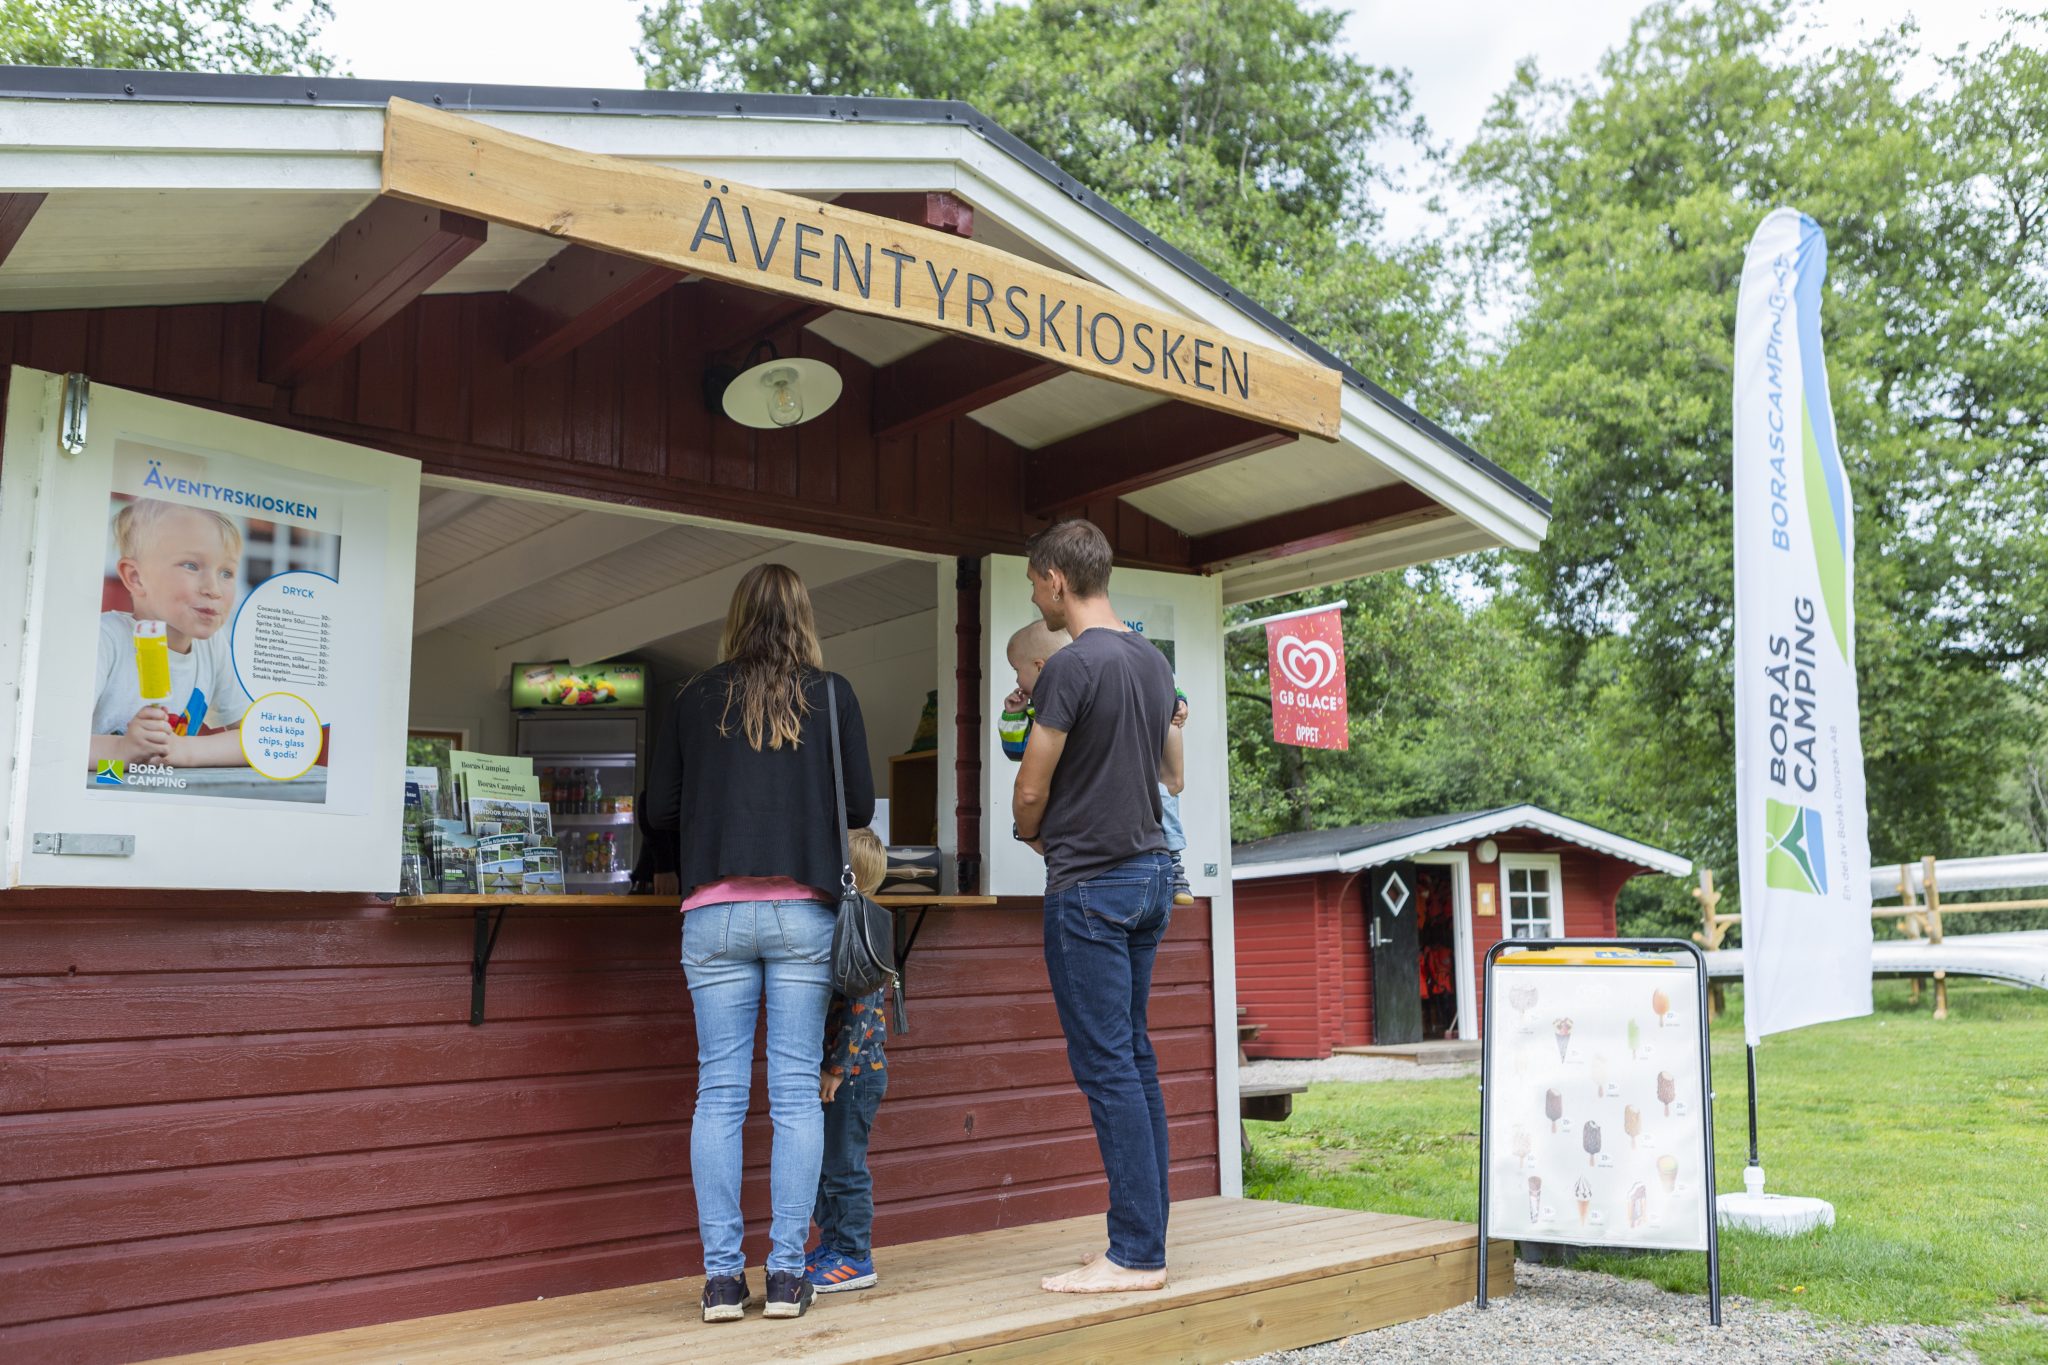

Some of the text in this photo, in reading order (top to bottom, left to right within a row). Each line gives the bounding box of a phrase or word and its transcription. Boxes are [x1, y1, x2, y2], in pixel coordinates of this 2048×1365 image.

[690, 179, 1249, 400] ÄVENTYRSKIOSKEN
[143, 460, 318, 520] ÄVENTYRSKIOSKEN
[282, 585, 315, 599] DRYCK
[257, 604, 281, 614] Cocacola
[256, 612, 280, 621] Cocacola
[256, 620, 272, 628] Sprite
[255, 627, 270, 635] Fanta
[269, 637, 288, 645] persika
[268, 644, 285, 652] citron
[254, 650, 291, 660] Elefantvatten,
[253, 658, 291, 668] Elefantvatten,
[253, 665, 272, 673] Smakis
[252, 673, 271, 681] Smakis
[1279, 689, 1337, 711] GB GLACE
[1794, 596, 1818, 793] CAMPING
[1765, 633, 1791, 787] BORÅS
[261, 711, 305, 724] Här kan du
[259, 725, 305, 736] också köpa
[1296, 722, 1319, 743] ÖPPET
[258, 736, 305, 748] chips, glass
[264, 749, 298, 760] & godis!
[128, 763, 174, 776] BORÅS
[481, 764, 511, 774] Camping
[127, 775, 187, 789] CAMPING
[497, 783, 527, 793] Camping
[1829, 725, 1851, 901] En del av Borås Djurpark AB
